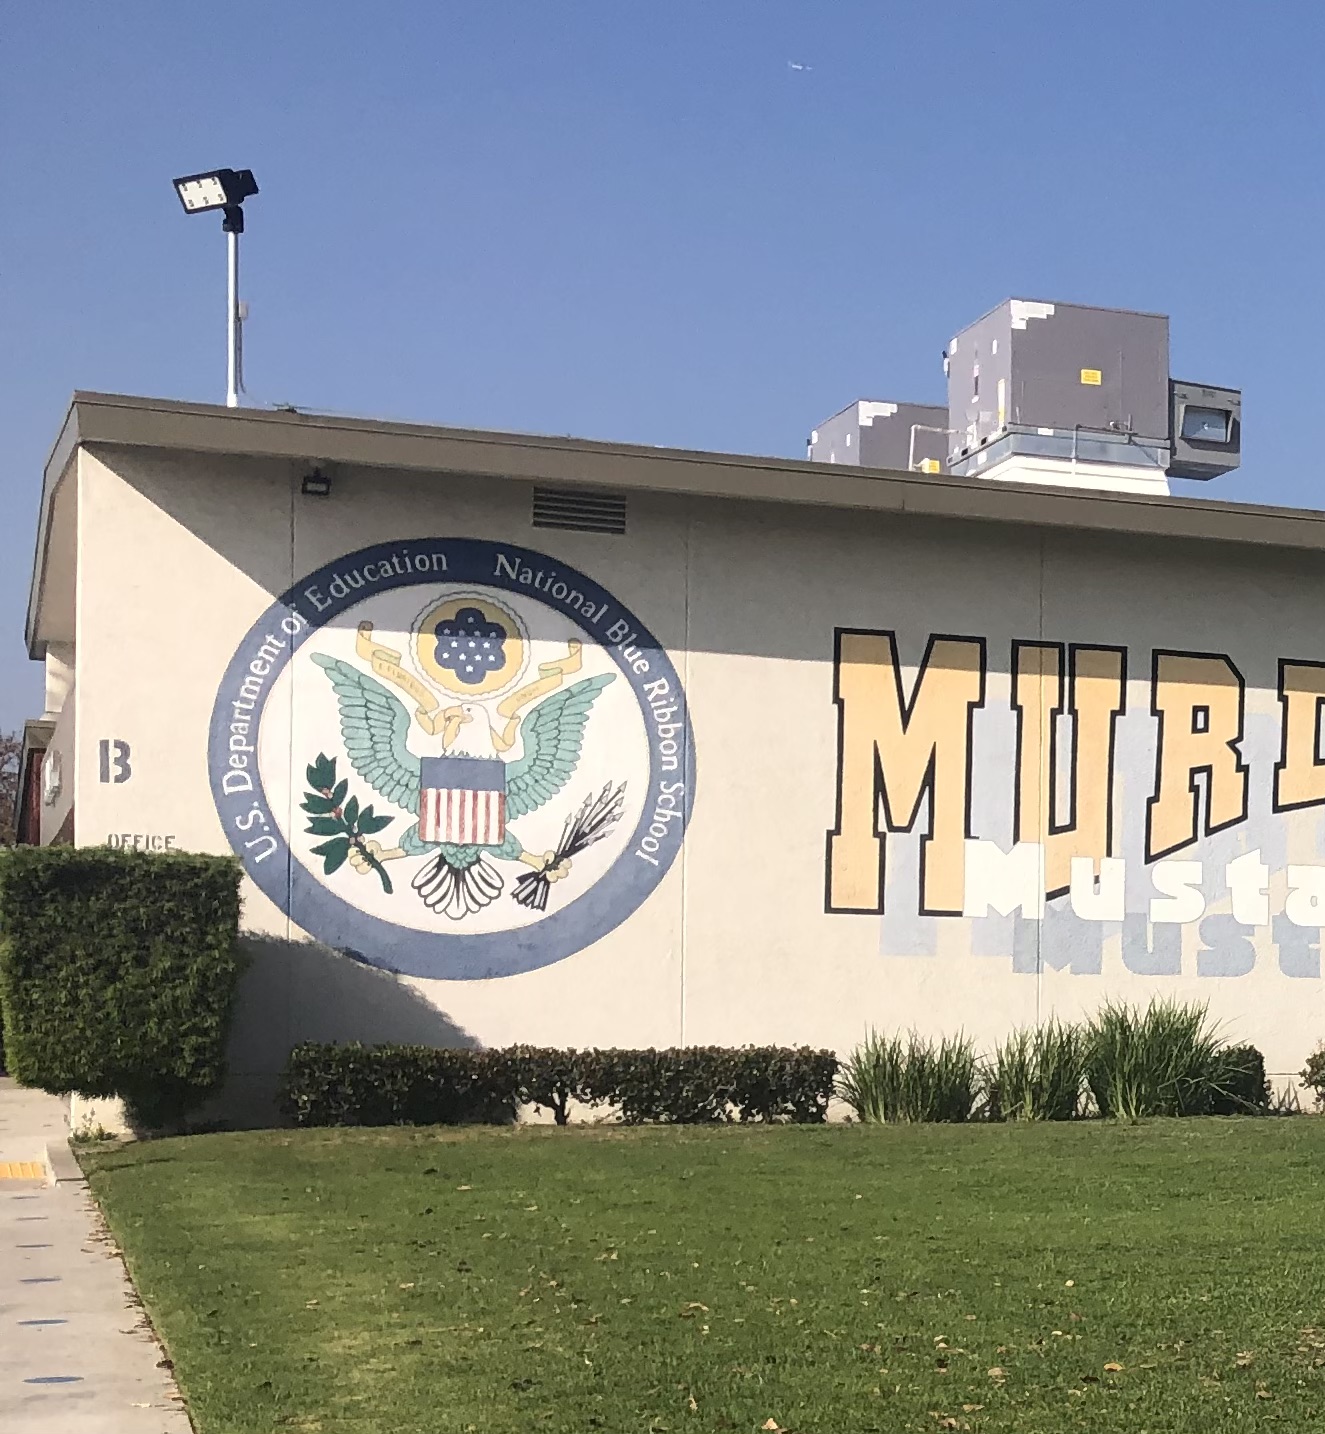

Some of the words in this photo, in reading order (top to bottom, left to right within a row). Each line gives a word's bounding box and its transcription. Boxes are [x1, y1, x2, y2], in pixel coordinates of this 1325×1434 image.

[304, 549, 448, 612] Education
[493, 553, 609, 625] National
[281, 602, 309, 635] of
[605, 618, 650, 675] Blue
[223, 632, 286, 796] Department
[643, 677, 683, 771] Ribbon
[99, 739, 132, 784] B
[107, 833, 176, 851] OFFICE
[235, 801, 278, 863] U.S.
[635, 780, 685, 866] School
